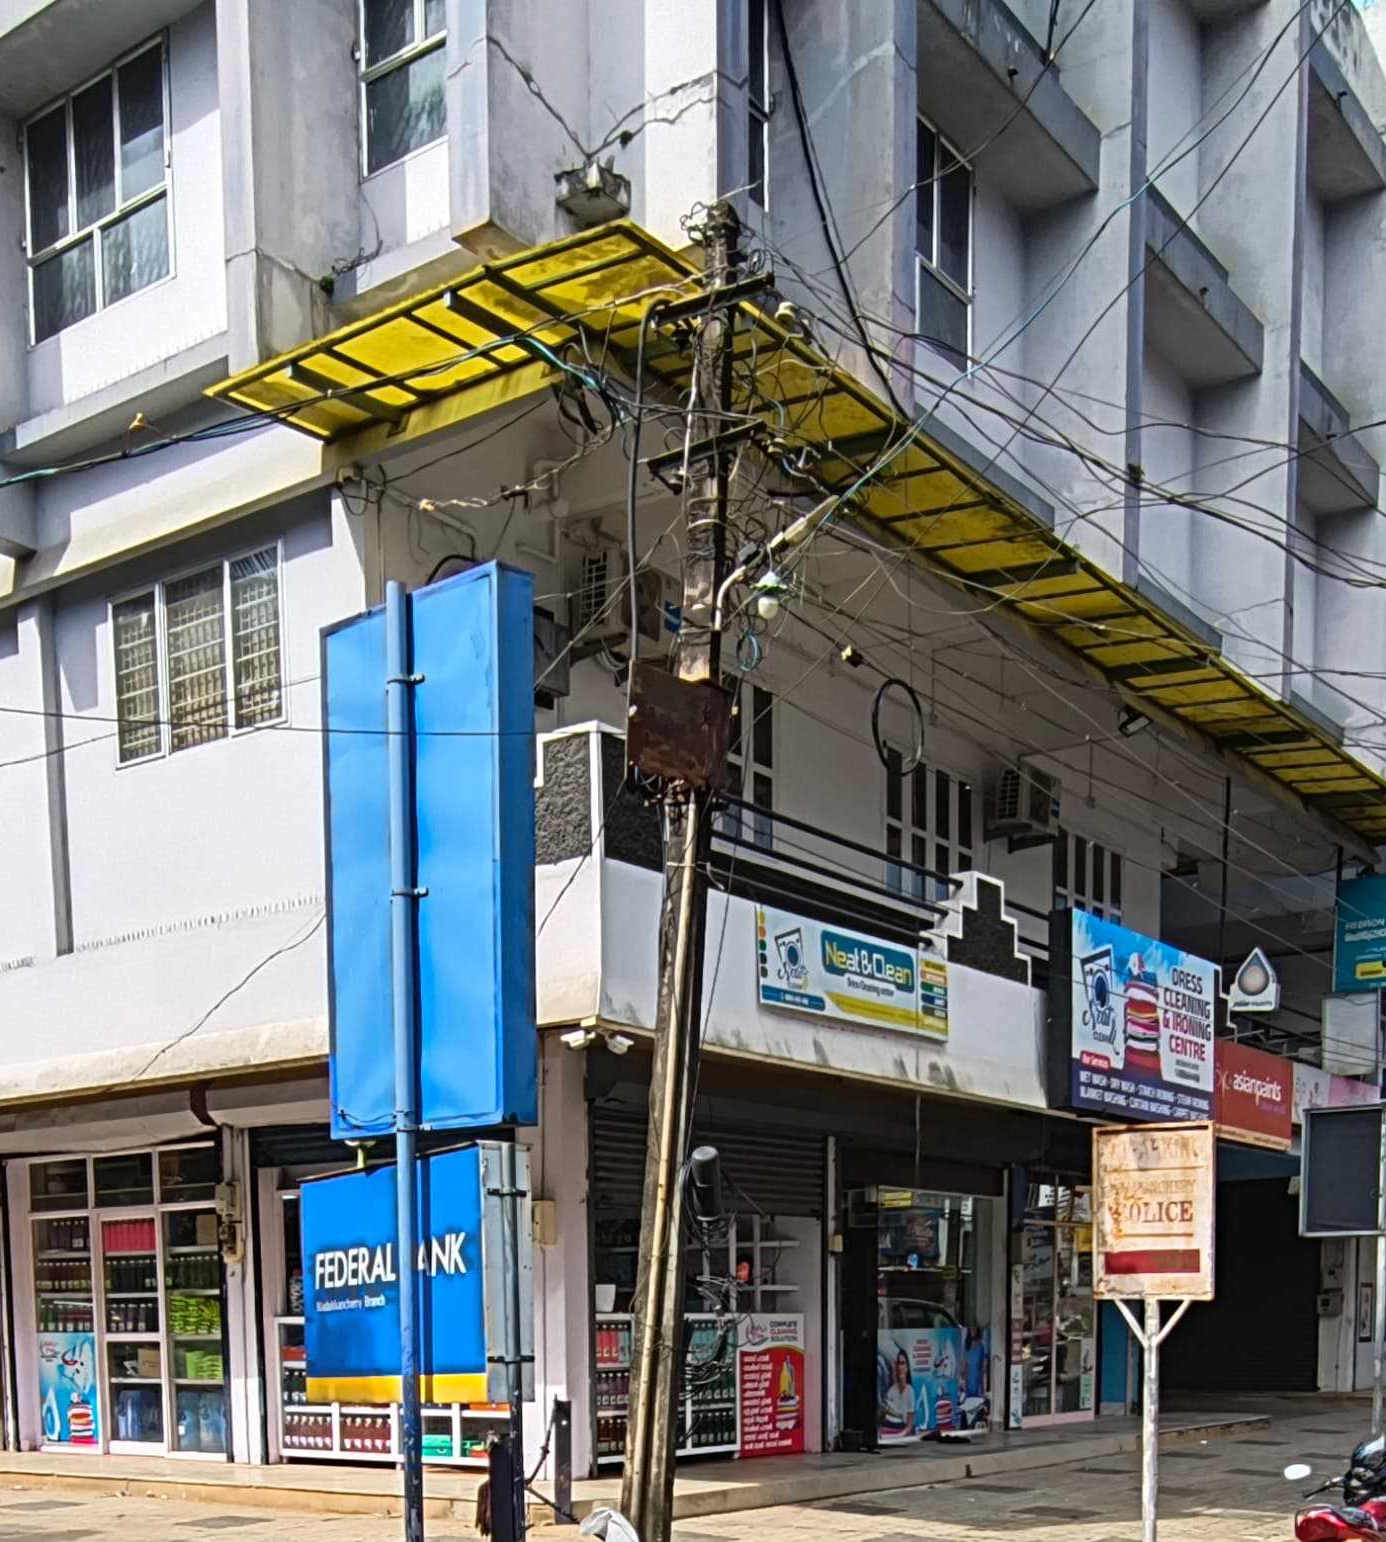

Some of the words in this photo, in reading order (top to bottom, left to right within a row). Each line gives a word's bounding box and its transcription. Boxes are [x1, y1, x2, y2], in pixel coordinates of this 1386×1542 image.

[1345, 918, 1385, 930] HEBRON
[1172, 967, 1203, 994] DRESS
[1163, 988, 1211, 1019] CLEANING
[1171, 1011, 1211, 1041] IRONING
[1169, 1034, 1206, 1061] CENTRE
[1092, 1073, 1108, 1086] WASH
[1121, 1080, 1135, 1093] WASH
[1233, 1069, 1283, 1107] asianpaints
[315, 1243, 397, 1290] FEDERAL
[417, 1232, 468, 1277] ANK
[364, 1293, 386, 1308] Branch
